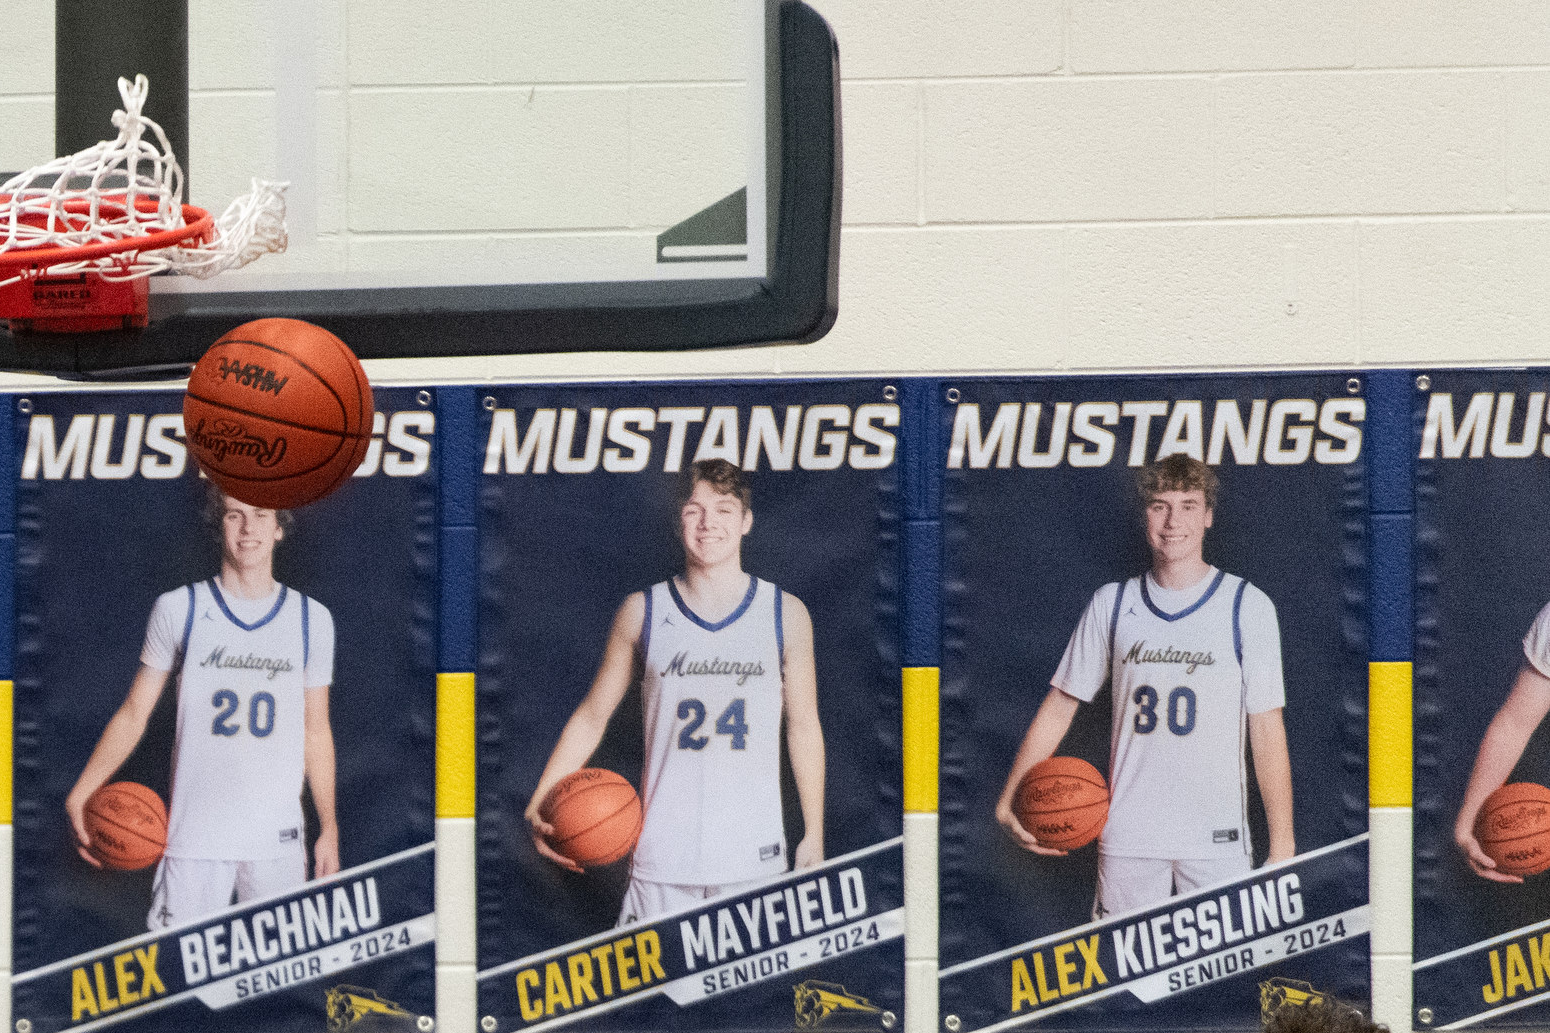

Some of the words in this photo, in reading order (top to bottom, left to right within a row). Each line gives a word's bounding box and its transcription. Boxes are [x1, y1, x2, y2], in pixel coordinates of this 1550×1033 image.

[482, 402, 901, 474] MUSTANGS
[946, 396, 1366, 469] MUSTANGS
[1418, 392, 1550, 459] MU
[199, 644, 293, 681] Mustangs
[659, 649, 766, 686] Mustangs
[1121, 640, 1216, 675] Mustangs
[211, 688, 276, 738] 20
[676, 698, 749, 751] 24
[1132, 684, 1197, 737] 30
[70, 943, 166, 1022] ALEX
[179, 876, 382, 985] BEACHNAU
[235, 954, 323, 1000] SENIOR
[350, 926, 413, 964] 2024
[515, 929, 666, 1023] CARTER
[679, 866, 868, 971] MAYFIELD
[702, 950, 790, 995] SENIOR
[819, 920, 881, 958] 2024
[1010, 933, 1110, 1013] ALEX
[1111, 872, 1305, 980] KIESSLING
[1168, 948, 1256, 992] SENIOR
[1284, 917, 1347, 956] 2024
